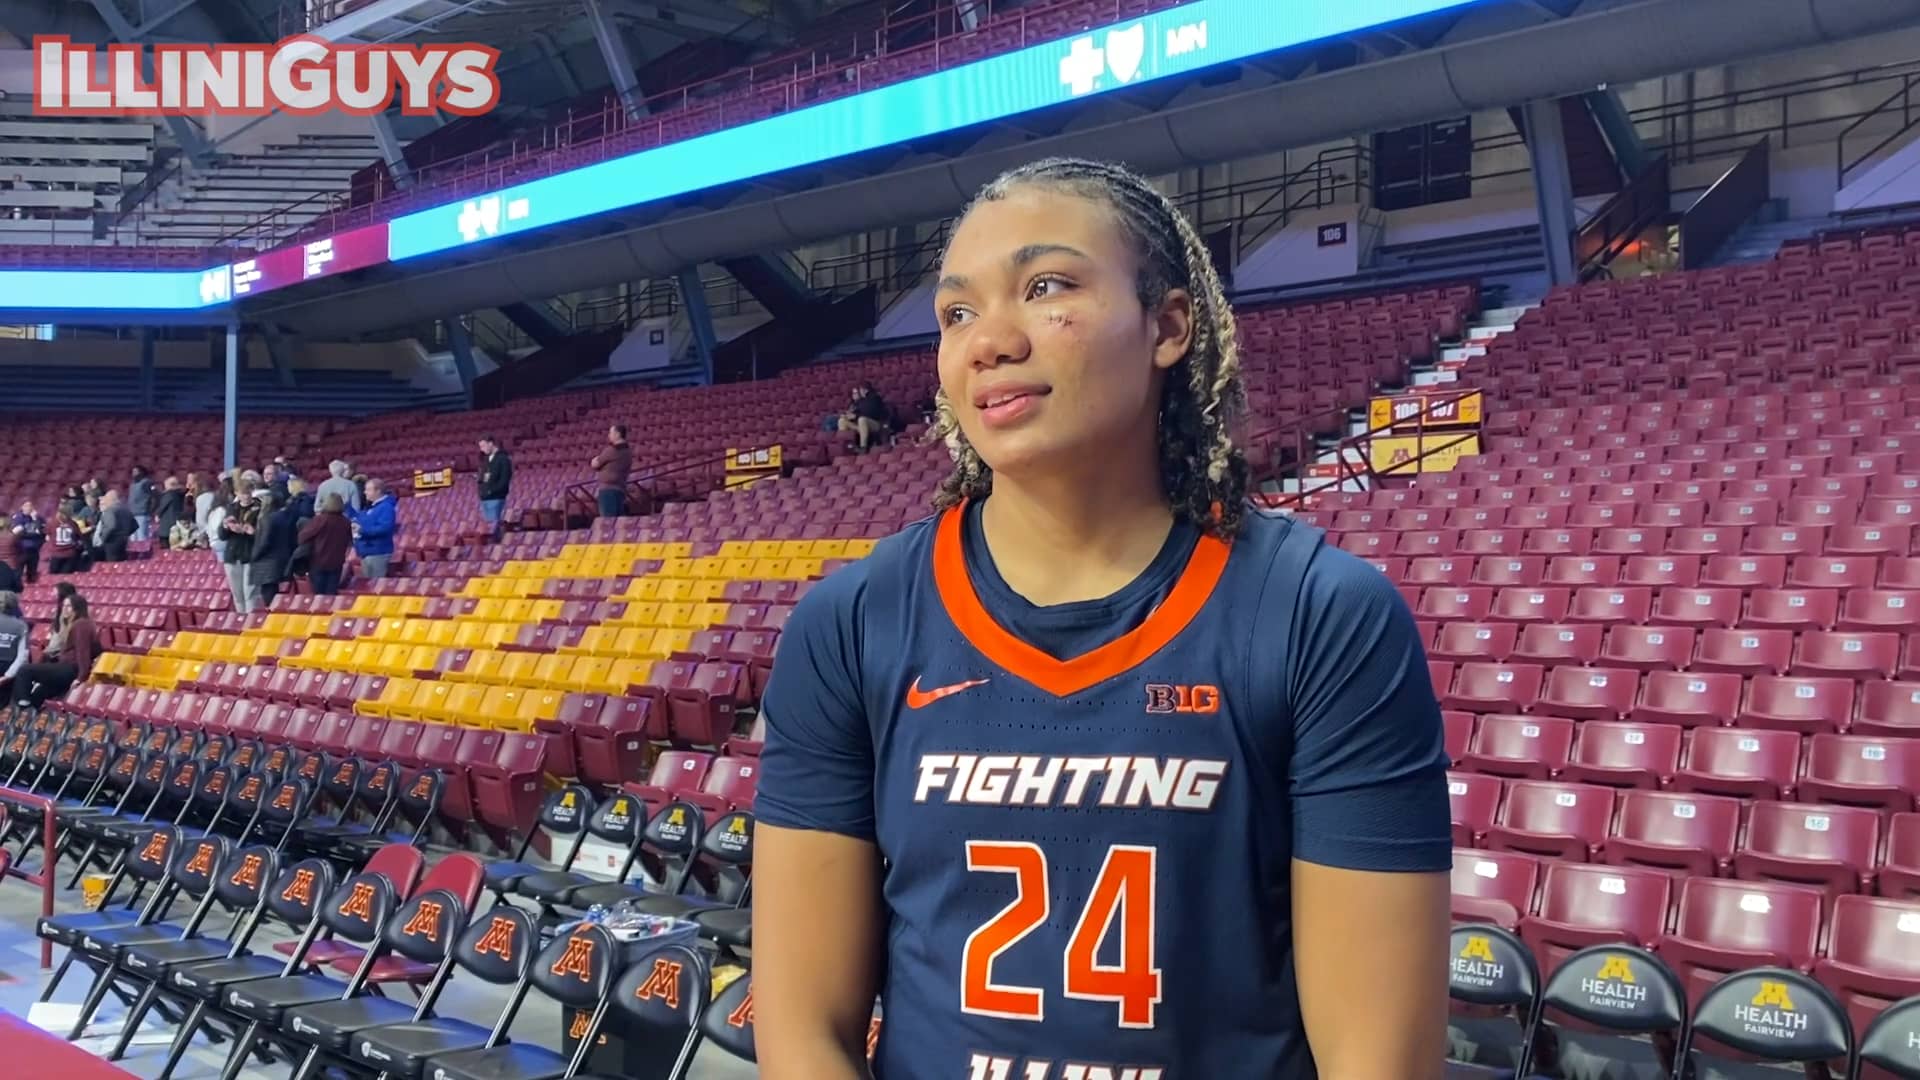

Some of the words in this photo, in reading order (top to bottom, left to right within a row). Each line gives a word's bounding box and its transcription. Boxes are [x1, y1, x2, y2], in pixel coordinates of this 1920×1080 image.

[913, 753, 1228, 809] FIGHTING
[960, 839, 1163, 1029] 24
[1581, 977, 1647, 1002] HEALTH
[1589, 995, 1636, 1010] FAIRVIEW
[1734, 1004, 1808, 1031] HEALTH
[1744, 1023, 1796, 1038] FAIRVIEW
